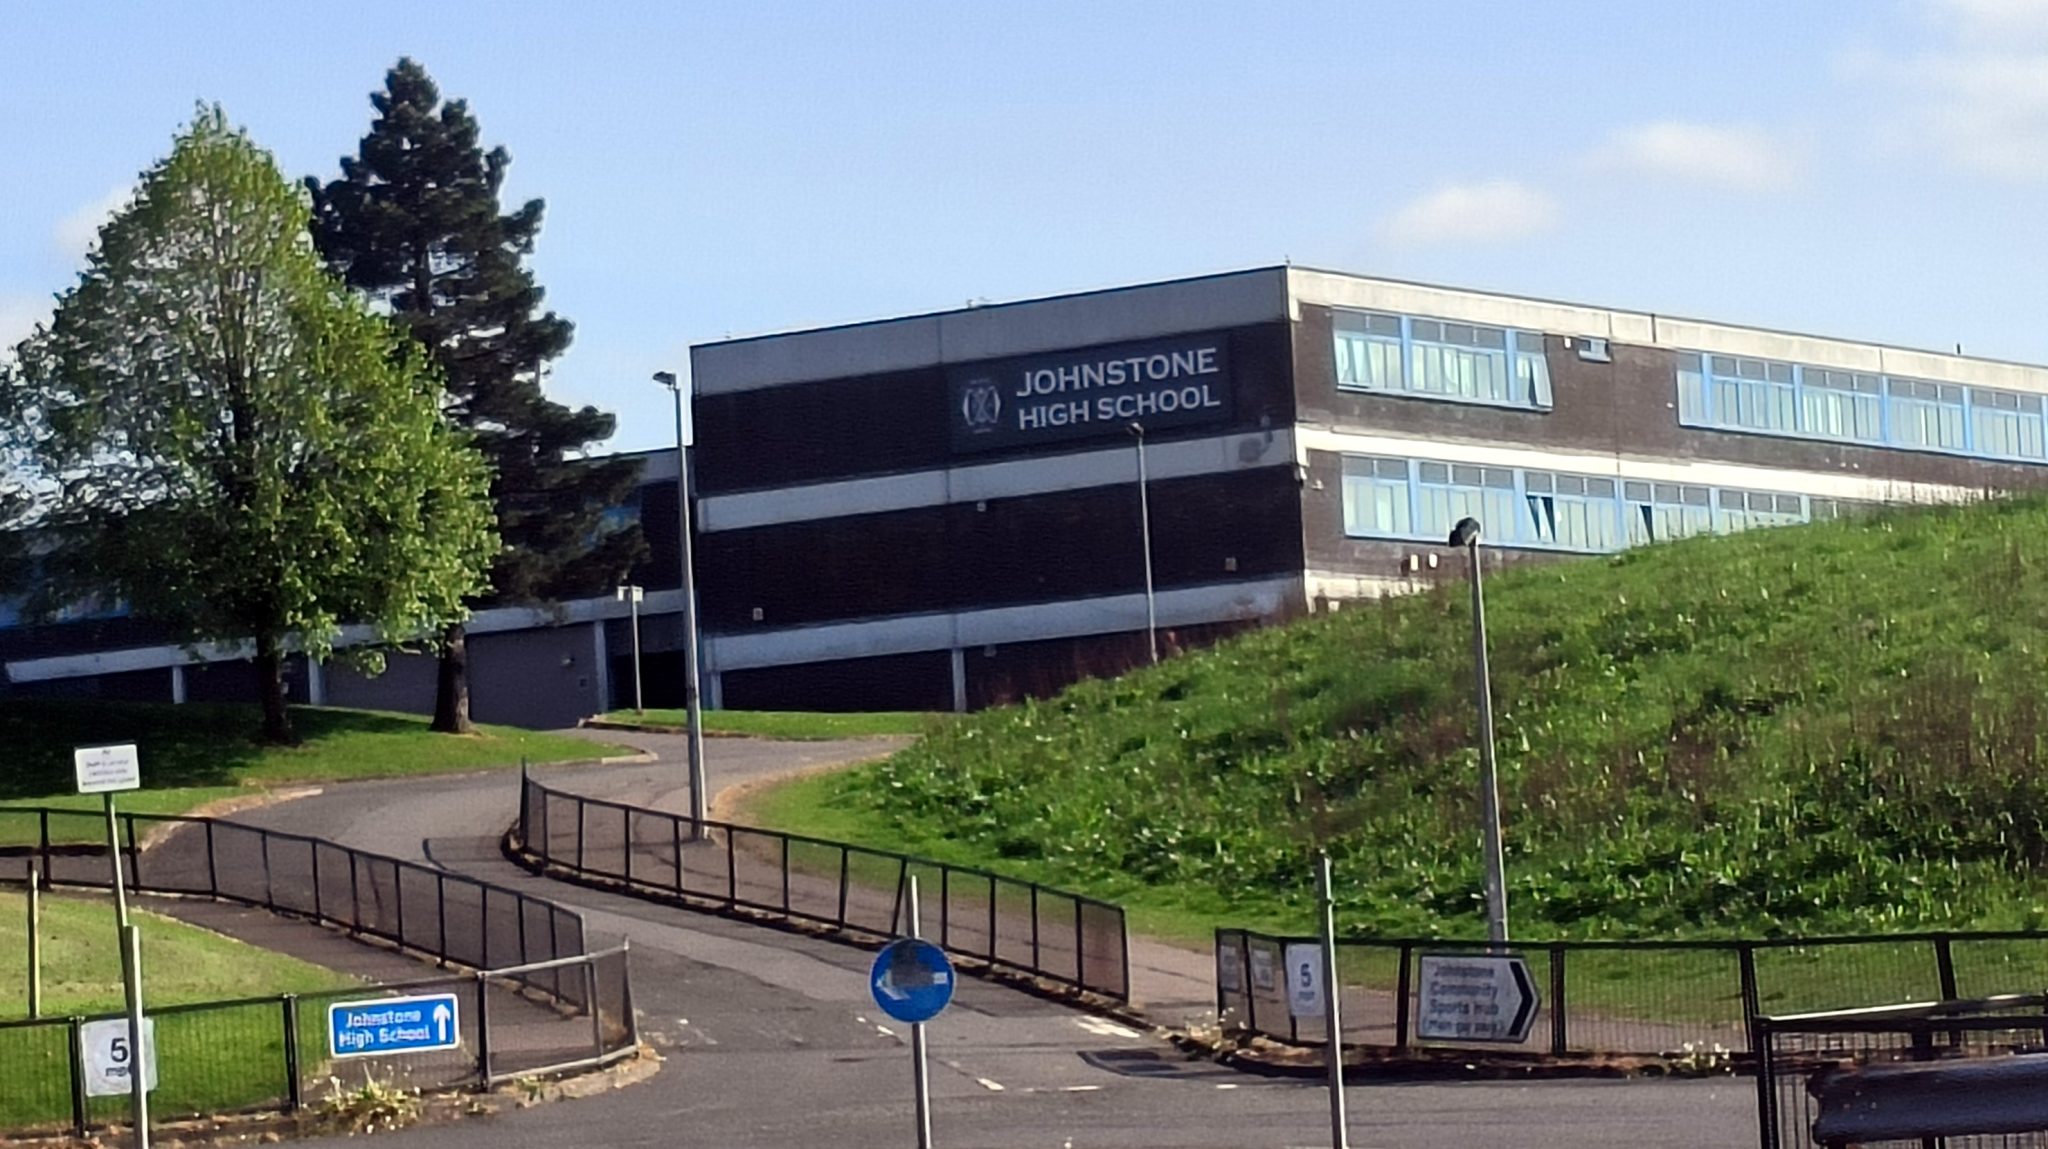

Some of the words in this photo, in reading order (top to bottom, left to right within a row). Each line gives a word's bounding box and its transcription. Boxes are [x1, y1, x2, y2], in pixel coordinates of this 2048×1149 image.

[1016, 347, 1219, 397] JOHNSTONE
[1018, 400, 1090, 430] HIGH
[1097, 385, 1221, 420] SCHOOL
[1301, 963, 1312, 987] 5
[345, 1009, 422, 1029] Johnstone
[110, 1036, 129, 1063] 5
[338, 1028, 375, 1049] High
[378, 1024, 431, 1044] School
